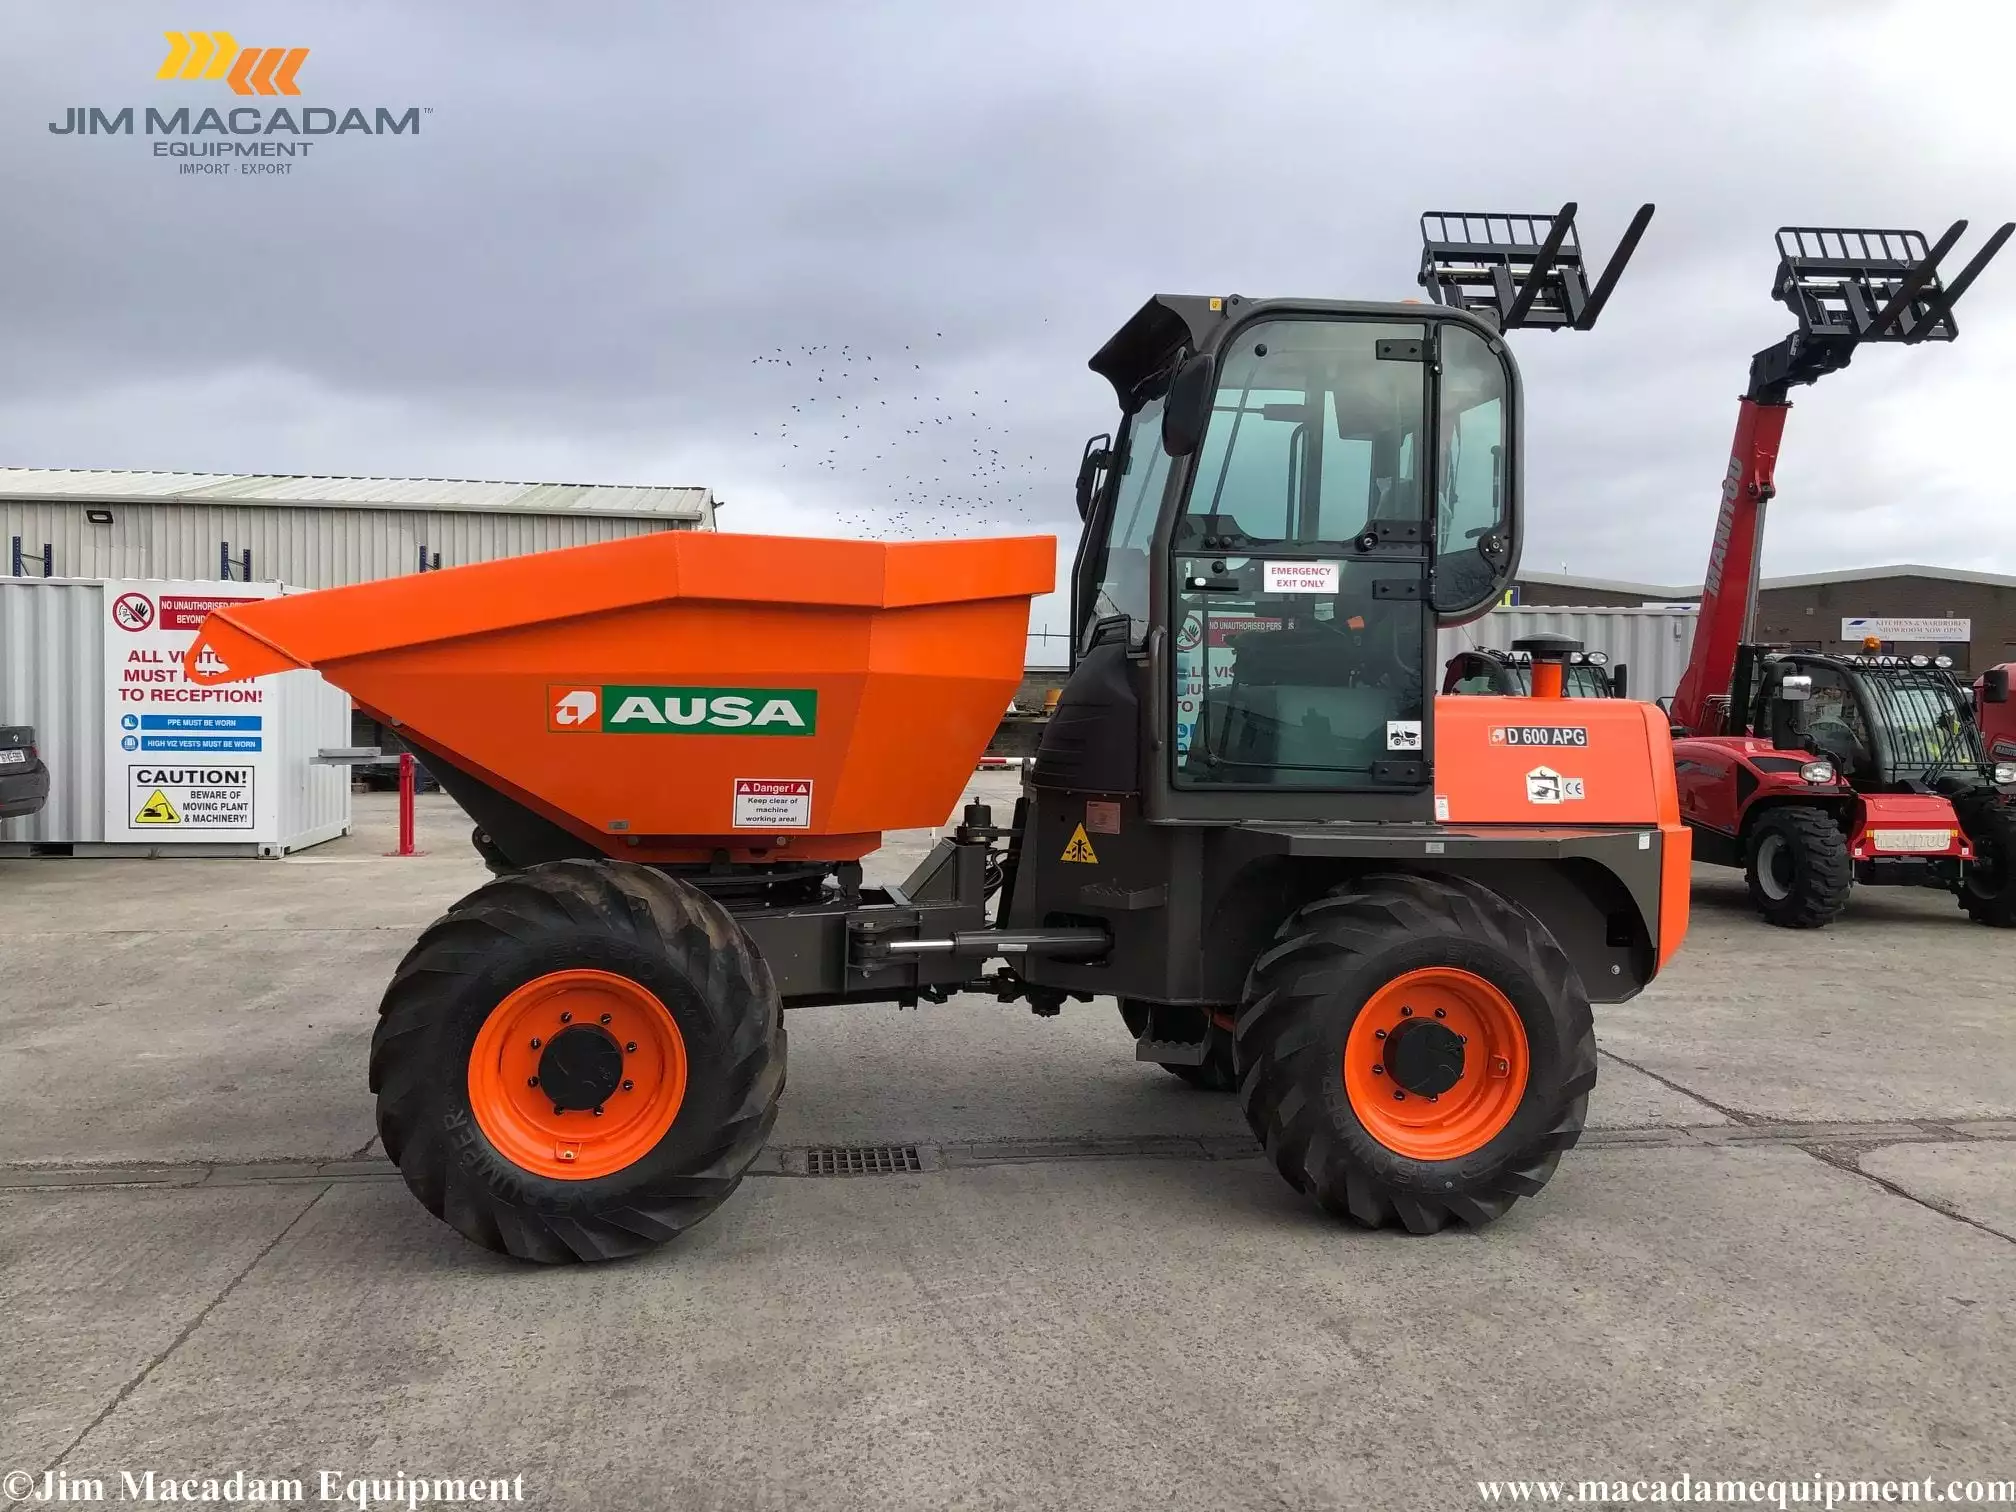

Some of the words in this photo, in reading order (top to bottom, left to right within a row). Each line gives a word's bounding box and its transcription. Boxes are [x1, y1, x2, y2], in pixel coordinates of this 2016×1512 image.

[1271, 566, 1331, 576] EMERGENCY
[1276, 579, 1297, 588] EXIT
[1299, 580, 1325, 588] ONLY
[161, 600, 173, 610] NO
[1209, 621, 1218, 630] NO
[1219, 621, 1265, 630] UNAUTHORISED
[127, 650, 163, 663] ALL
[124, 669, 178, 683] MUST
[118, 689, 144, 702] TO
[150, 689, 263, 703] RECEPTION!
[609, 696, 806, 727] AUSA
[183, 719, 202, 727] MUST
[203, 719, 213, 727] BE
[215, 719, 236, 727] WORN
[1507, 728, 1519, 744] D
[1522, 728, 1549, 744] 600
[1552, 728, 1585, 745] APG
[202, 740, 222, 748] MUST
[136, 769, 247, 784] CAUTION!
[190, 790, 227, 799] BEWARE
[229, 791, 241, 799] OF
[747, 797, 767, 805] Keep
[182, 802, 218, 811] MOVING
[220, 803, 249, 811] PLANT
[756, 806, 789, 814] machine
[184, 814, 190, 823] &
[192, 814, 247, 823] MACHINERY!
[745, 816, 777, 824] working
